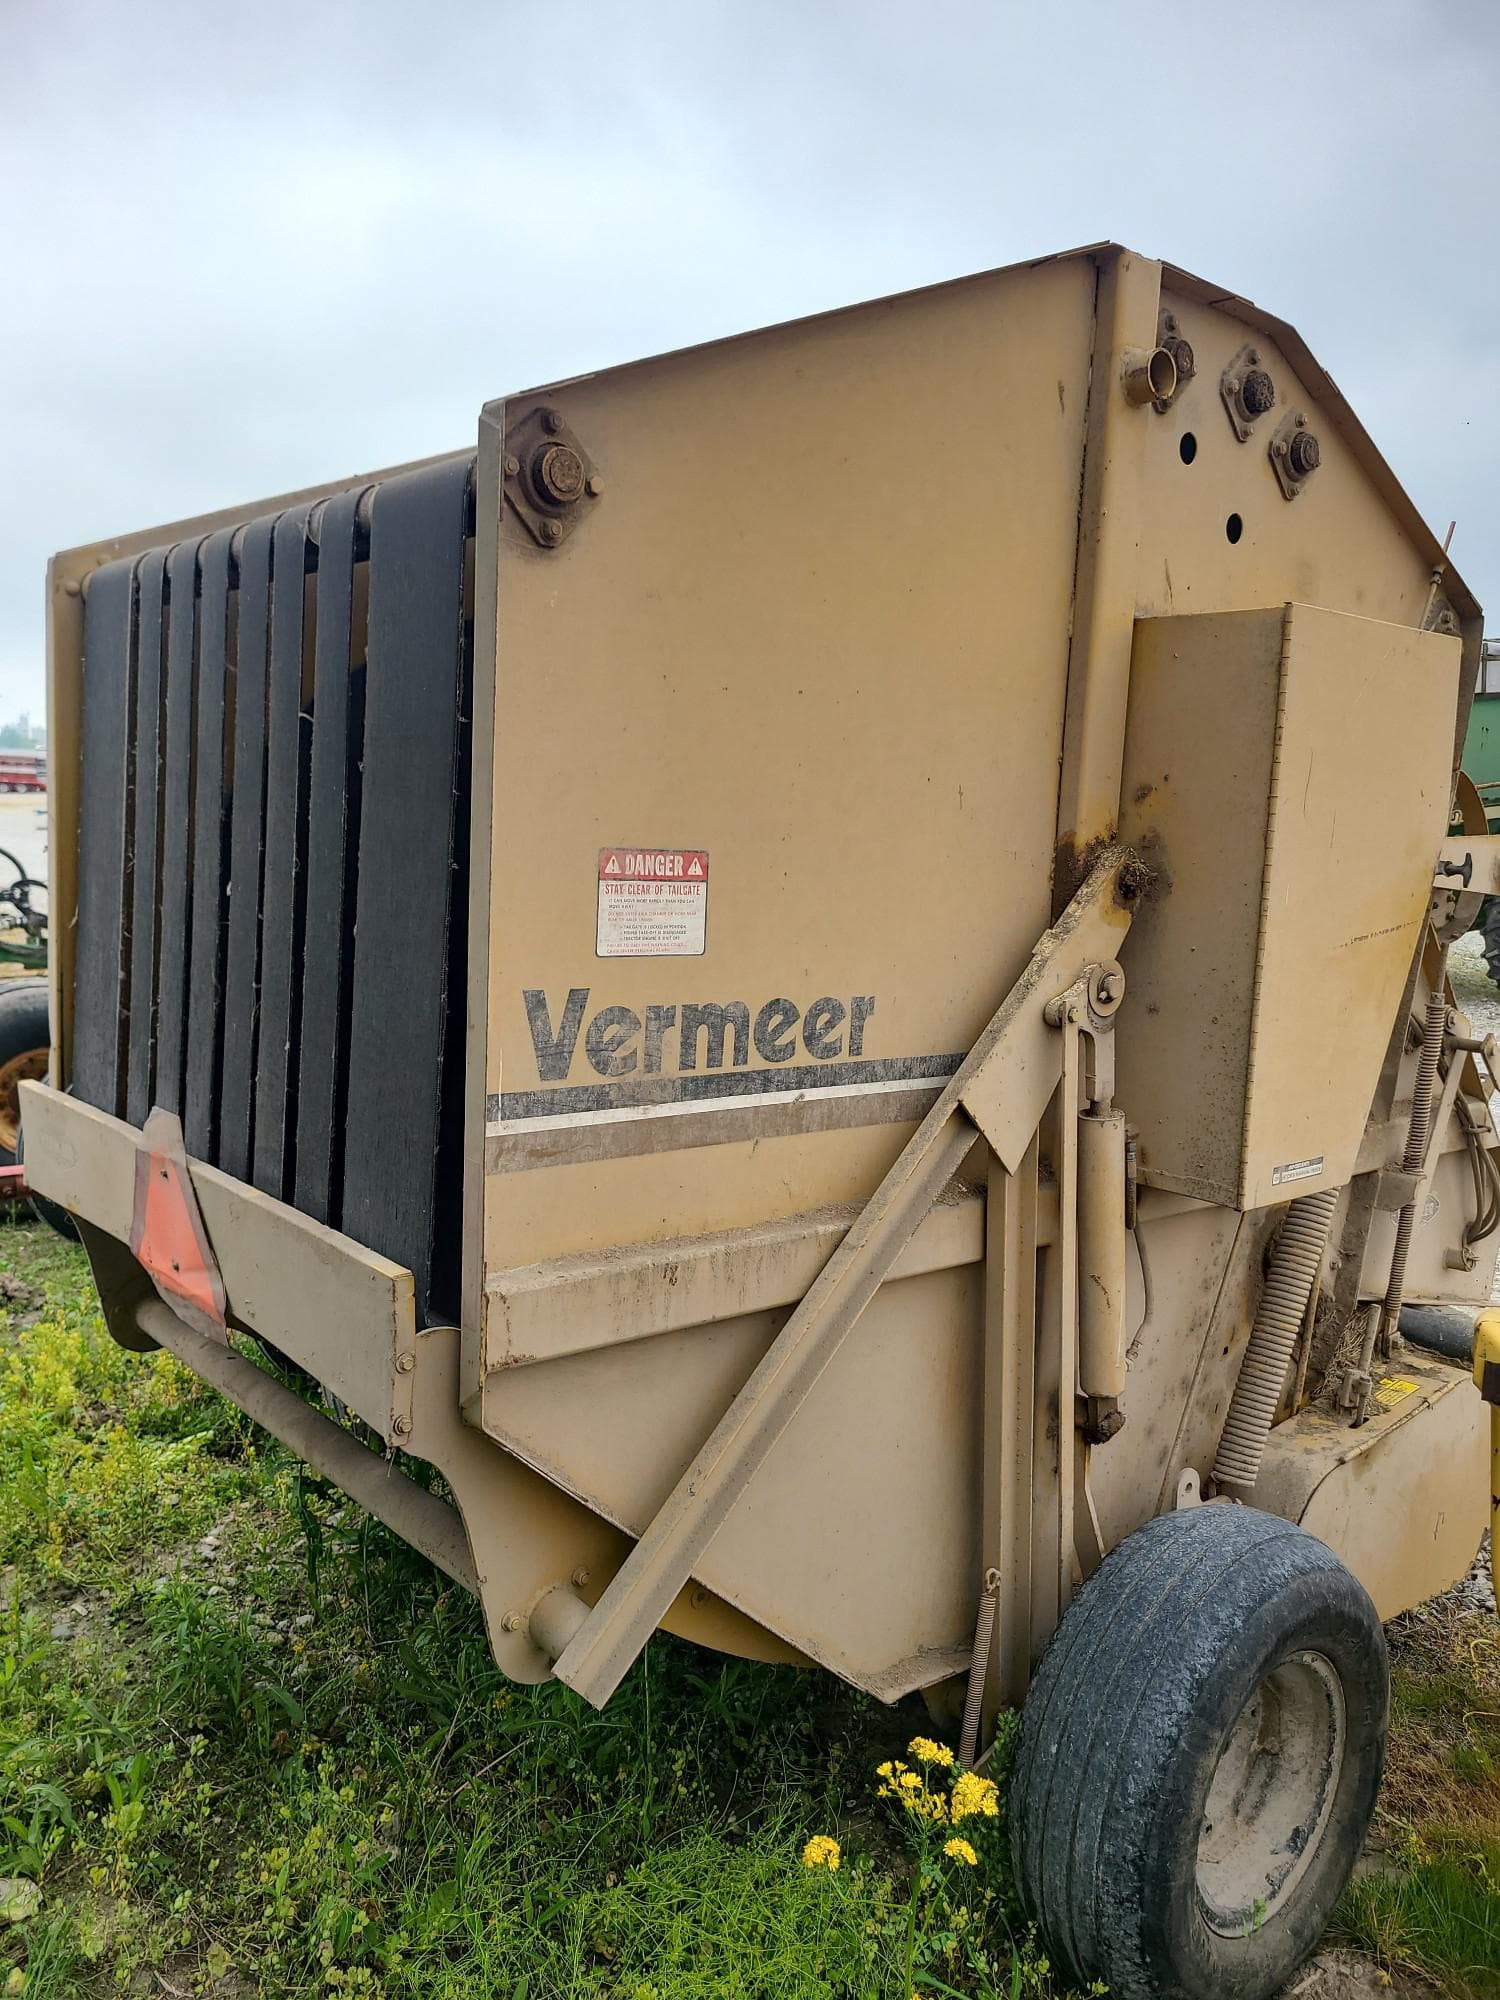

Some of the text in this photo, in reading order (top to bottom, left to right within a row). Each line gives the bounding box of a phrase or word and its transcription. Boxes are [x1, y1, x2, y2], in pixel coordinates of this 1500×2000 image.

[625, 854, 684, 877] DANGER
[604, 883, 701, 897] STAY CLEAR OF TAILGATE
[522, 987, 876, 1082] Vermeer
